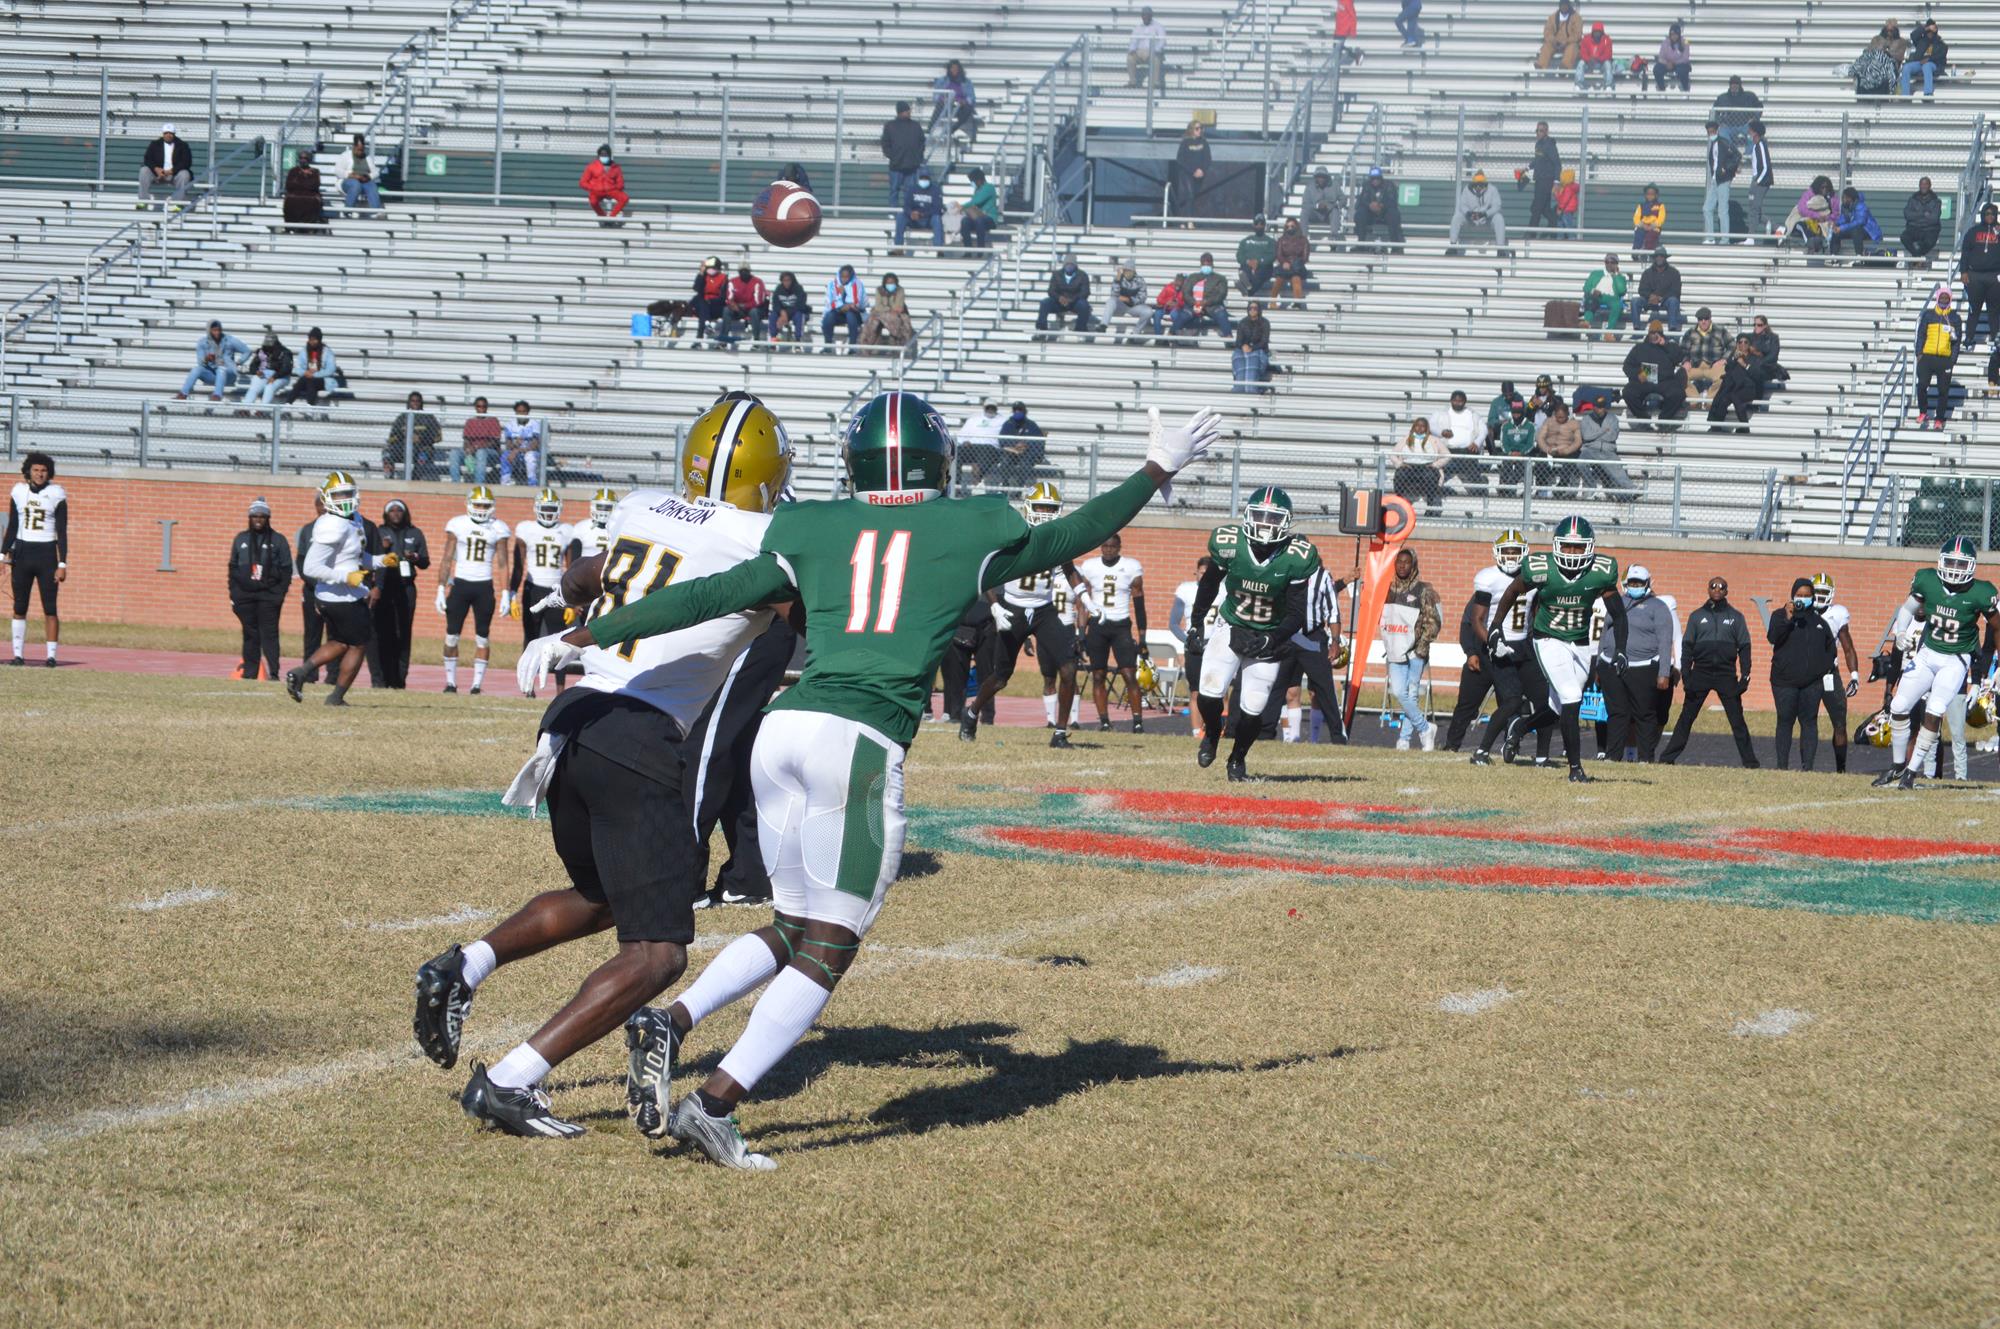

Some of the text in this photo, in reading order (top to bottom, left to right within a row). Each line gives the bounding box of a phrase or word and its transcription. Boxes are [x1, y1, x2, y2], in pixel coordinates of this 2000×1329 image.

[430, 156, 443, 173] G
[1404, 186, 1417, 203] F
[734, 469, 743, 479] 81
[868, 492, 924, 505] Riddell
[1354, 490, 1369, 527] 1
[24, 507, 46, 530] 12
[649, 498, 715, 525] JOHNSON
[1216, 526, 1239, 544] 26
[467, 537, 487, 562] 18
[535, 544, 561, 569] 83
[1287, 538, 1312, 560] 26
[1528, 554, 1548, 571] 20
[1591, 556, 1613, 575] 20
[845, 529, 912, 633] 11
[1242, 579, 1269, 593] VALLEY
[1103, 583, 1116, 608] 2
[1234, 590, 1274, 622] 26
[1556, 596, 1581, 605] VALLEY
[1549, 605, 1584, 631] 20
[1936, 604, 1957, 618] VALLEY
[642, 1010, 668, 1083] VAPOR
